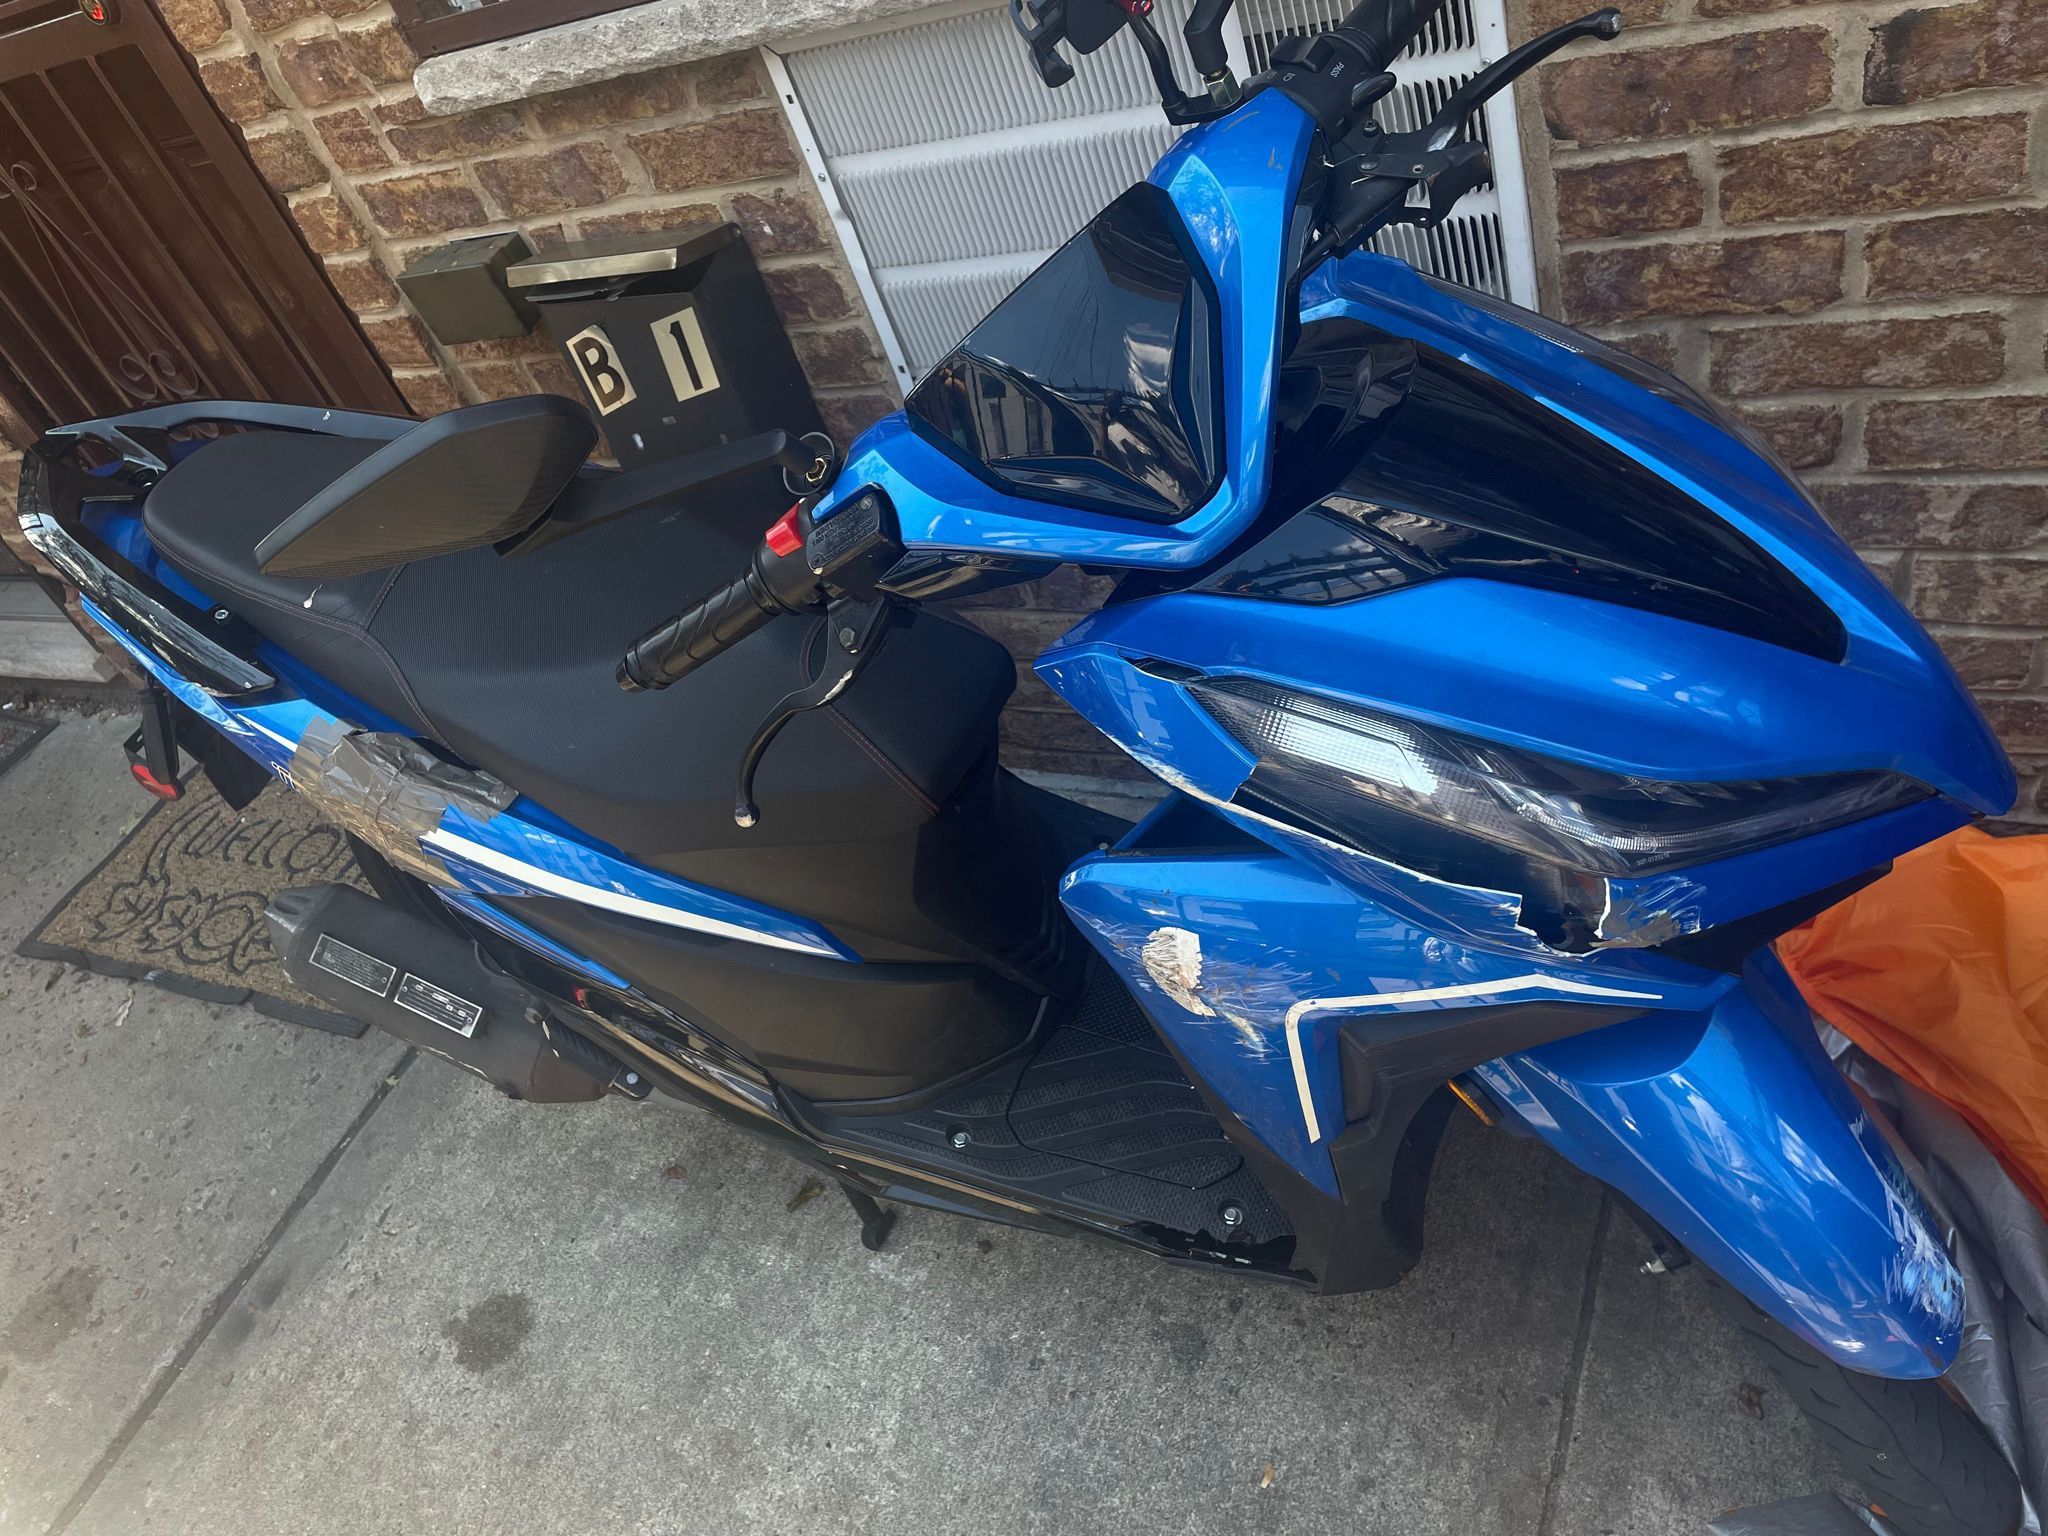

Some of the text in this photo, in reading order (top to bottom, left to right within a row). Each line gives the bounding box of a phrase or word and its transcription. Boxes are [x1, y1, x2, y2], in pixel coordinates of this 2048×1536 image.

[1330, 61, 1345, 78] PASS
[572, 320, 704, 409] B 1
